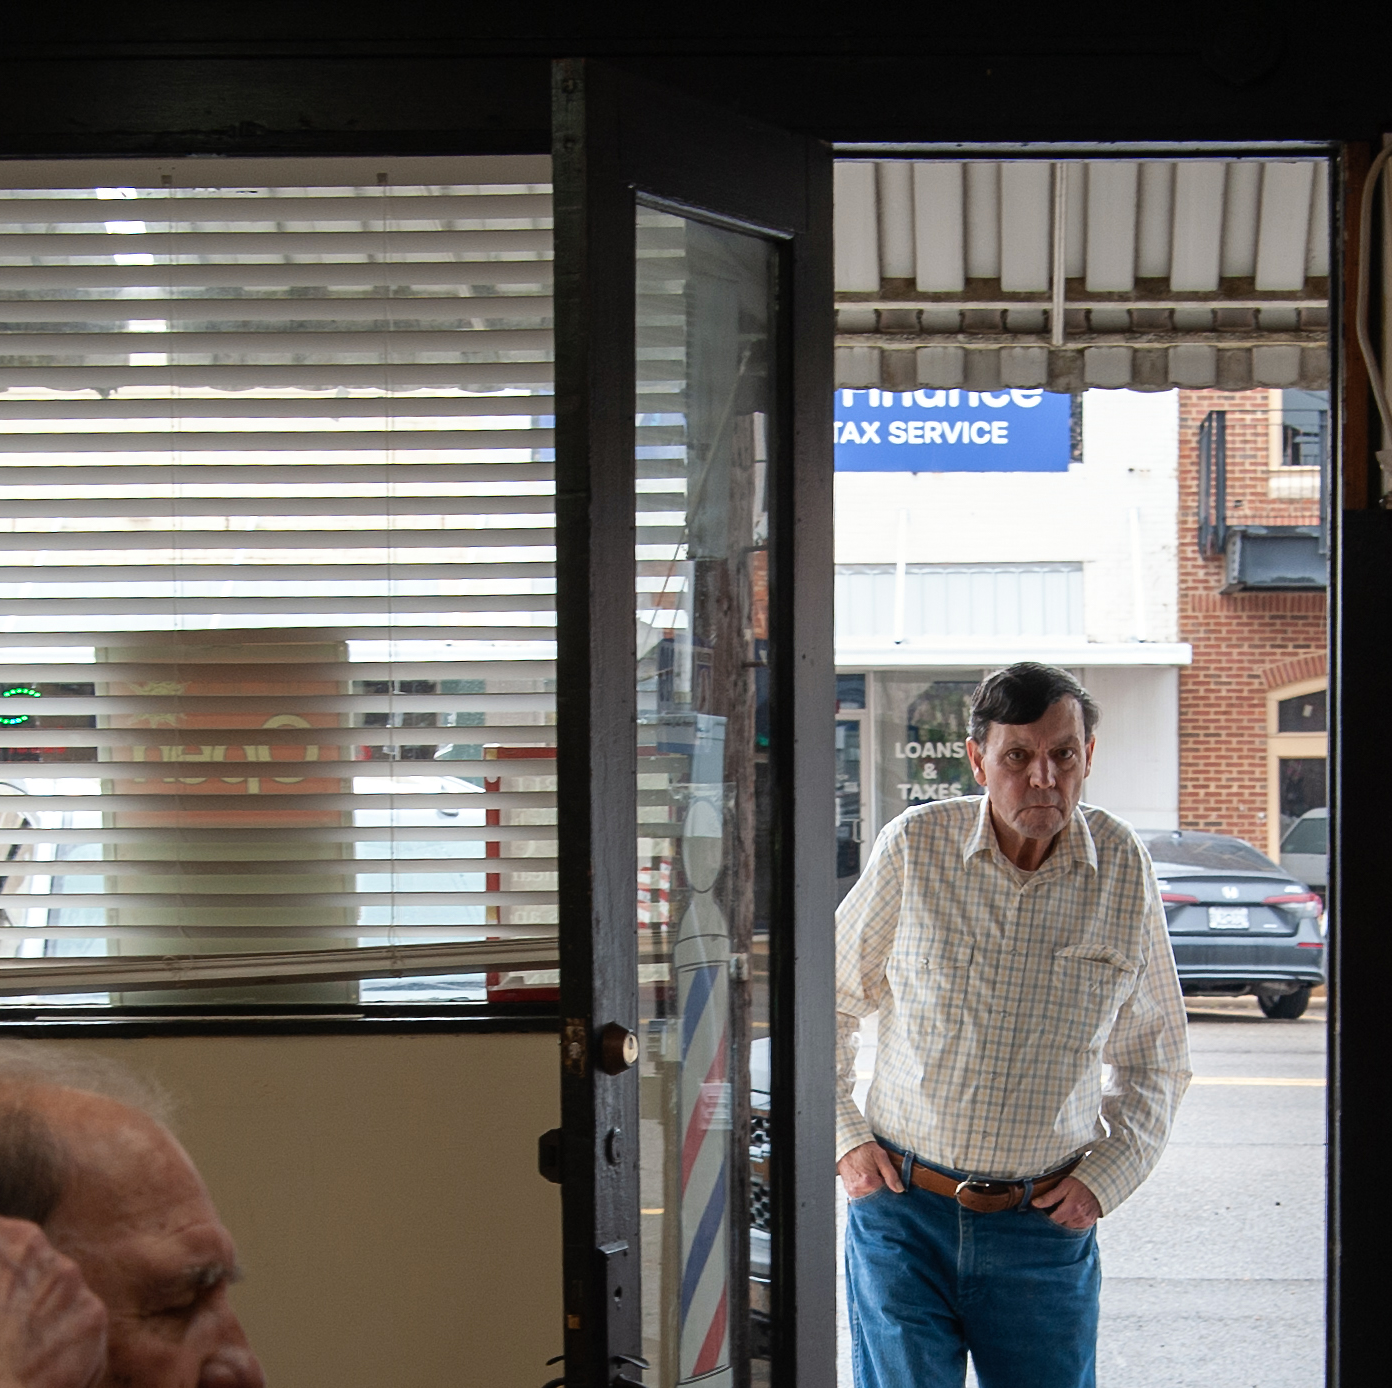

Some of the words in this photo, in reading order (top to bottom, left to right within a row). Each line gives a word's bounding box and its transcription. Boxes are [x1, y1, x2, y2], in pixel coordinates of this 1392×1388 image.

[888, 421, 1009, 444] SERVICE
[895, 741, 966, 759] LOANS
[922, 762, 938, 779] &
[897, 782, 963, 800] TAXES
